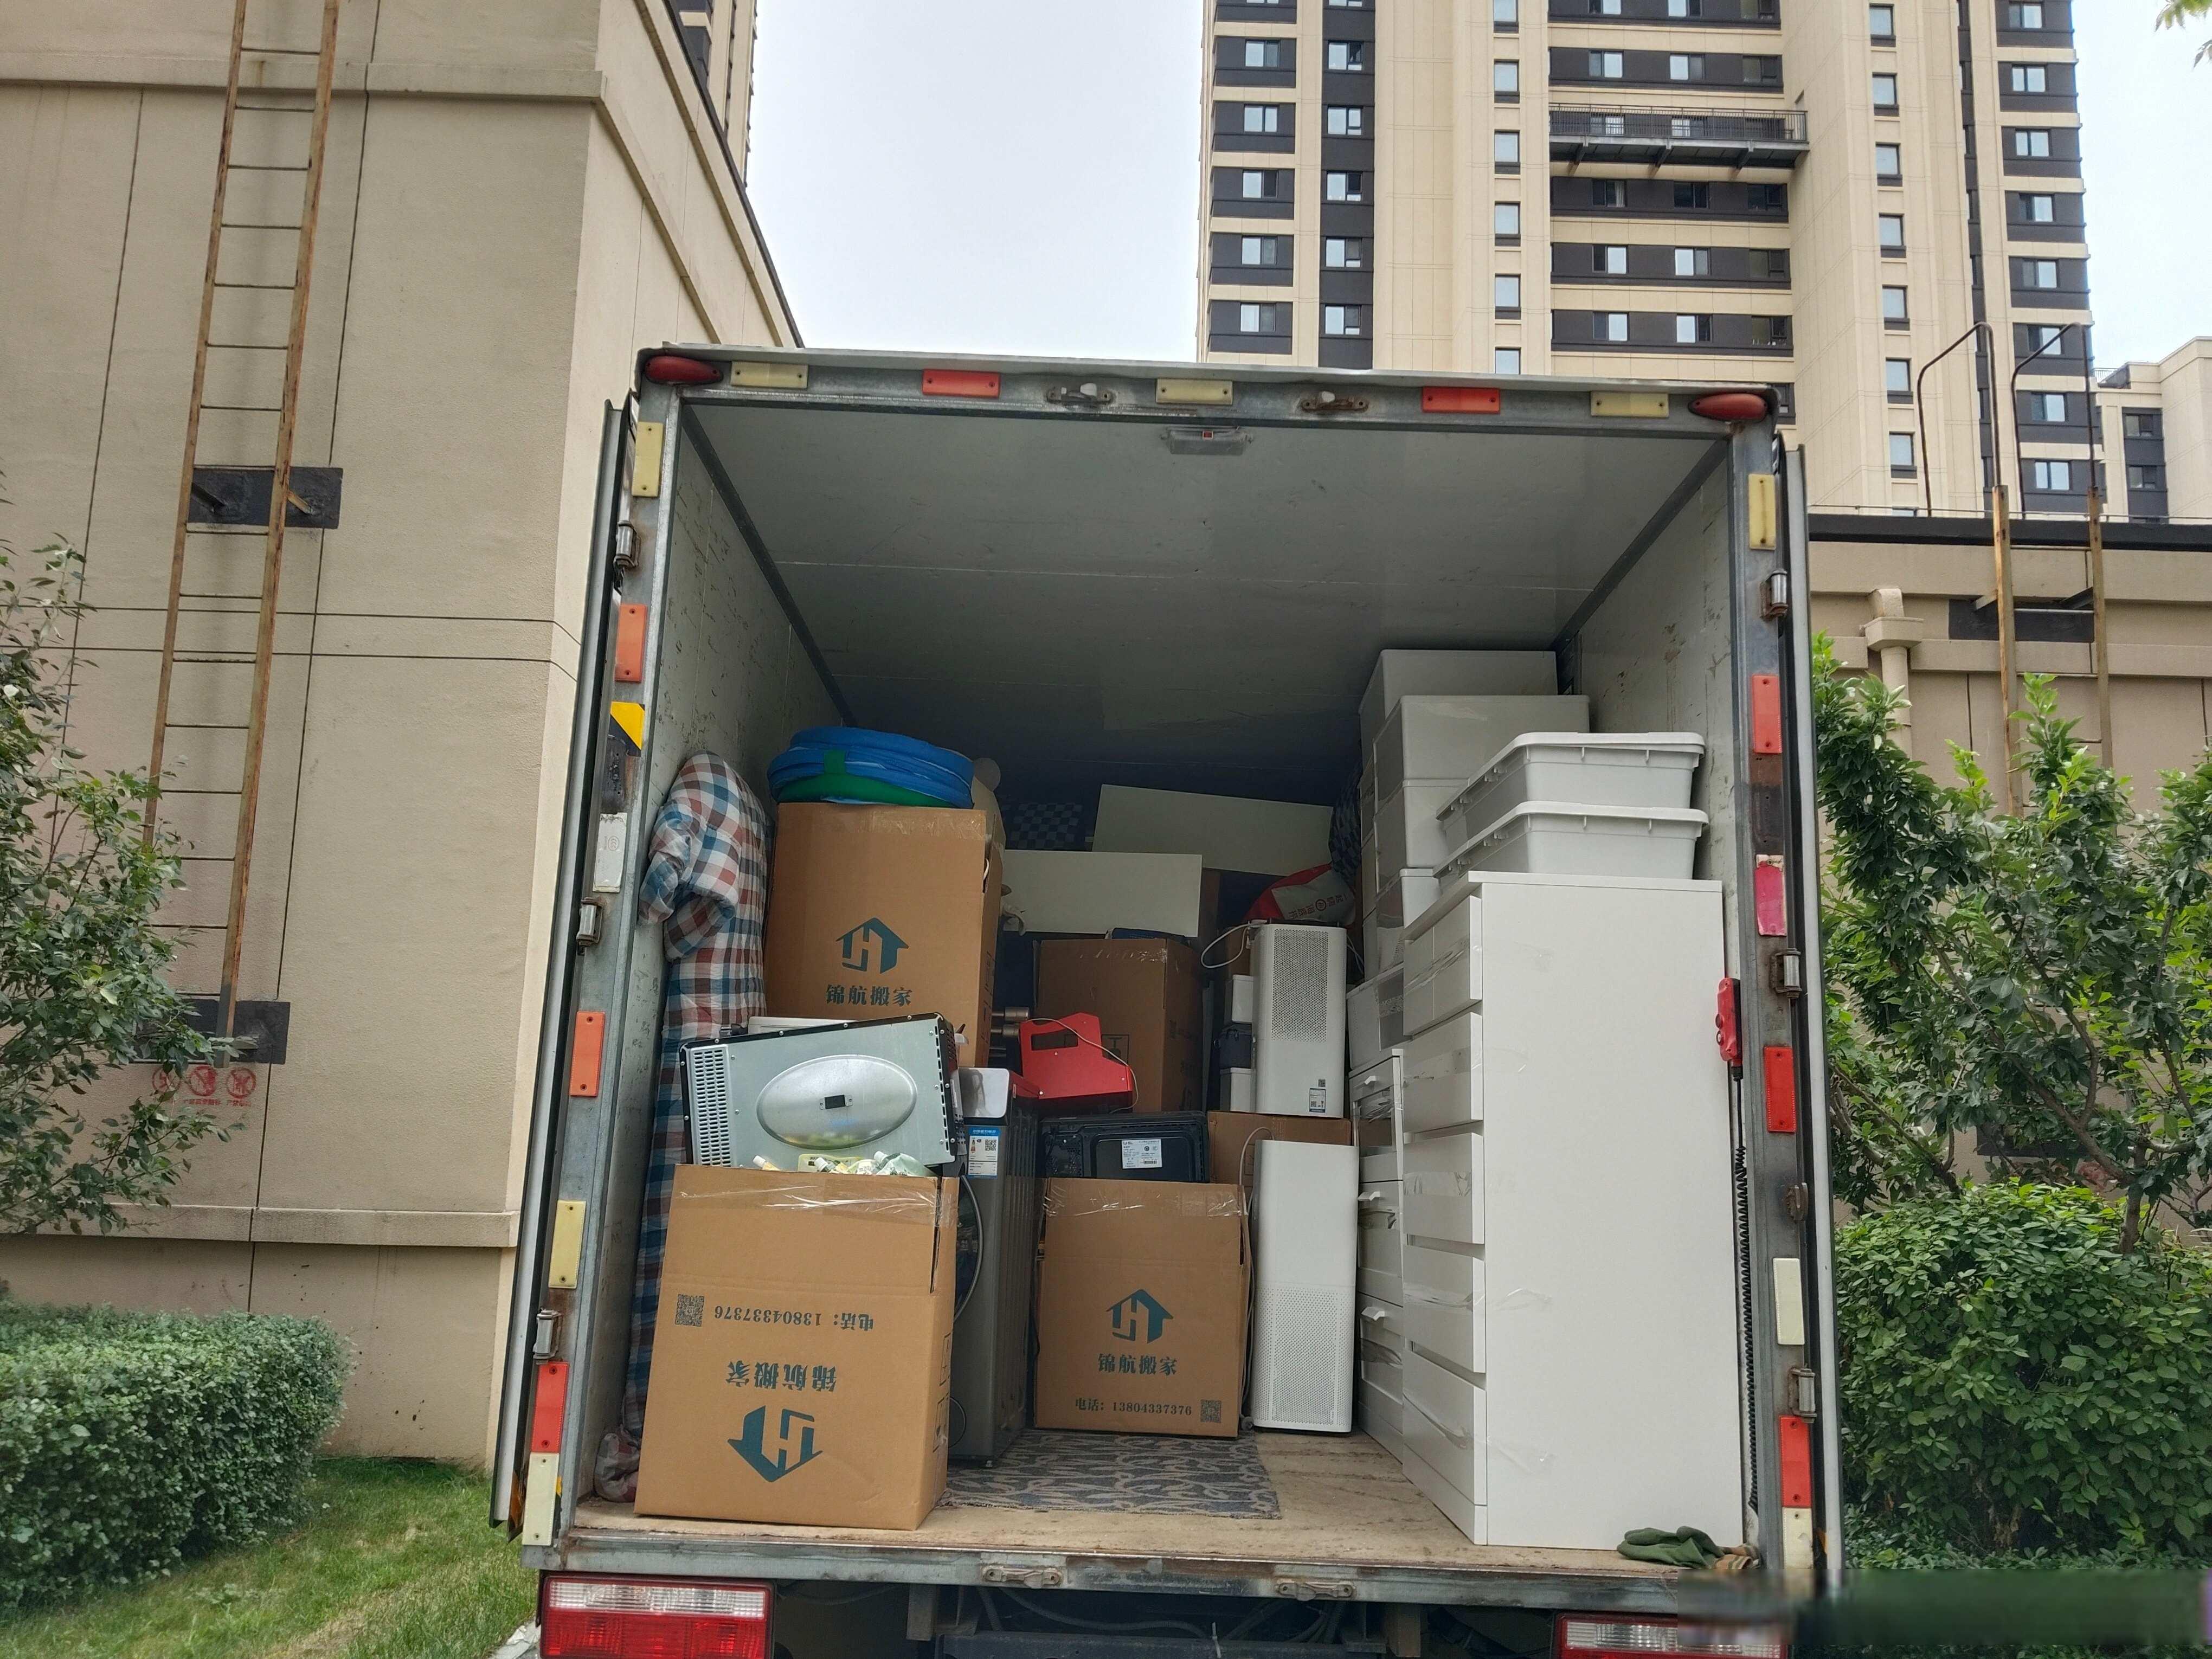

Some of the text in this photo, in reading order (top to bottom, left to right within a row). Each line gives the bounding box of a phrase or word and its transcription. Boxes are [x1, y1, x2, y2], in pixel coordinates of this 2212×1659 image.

[826, 984, 913, 1007] 锦航搬家
[1098, 1353, 1178, 1376] 锦航搬家
[725, 1360, 837, 1393] 锦航搬家
